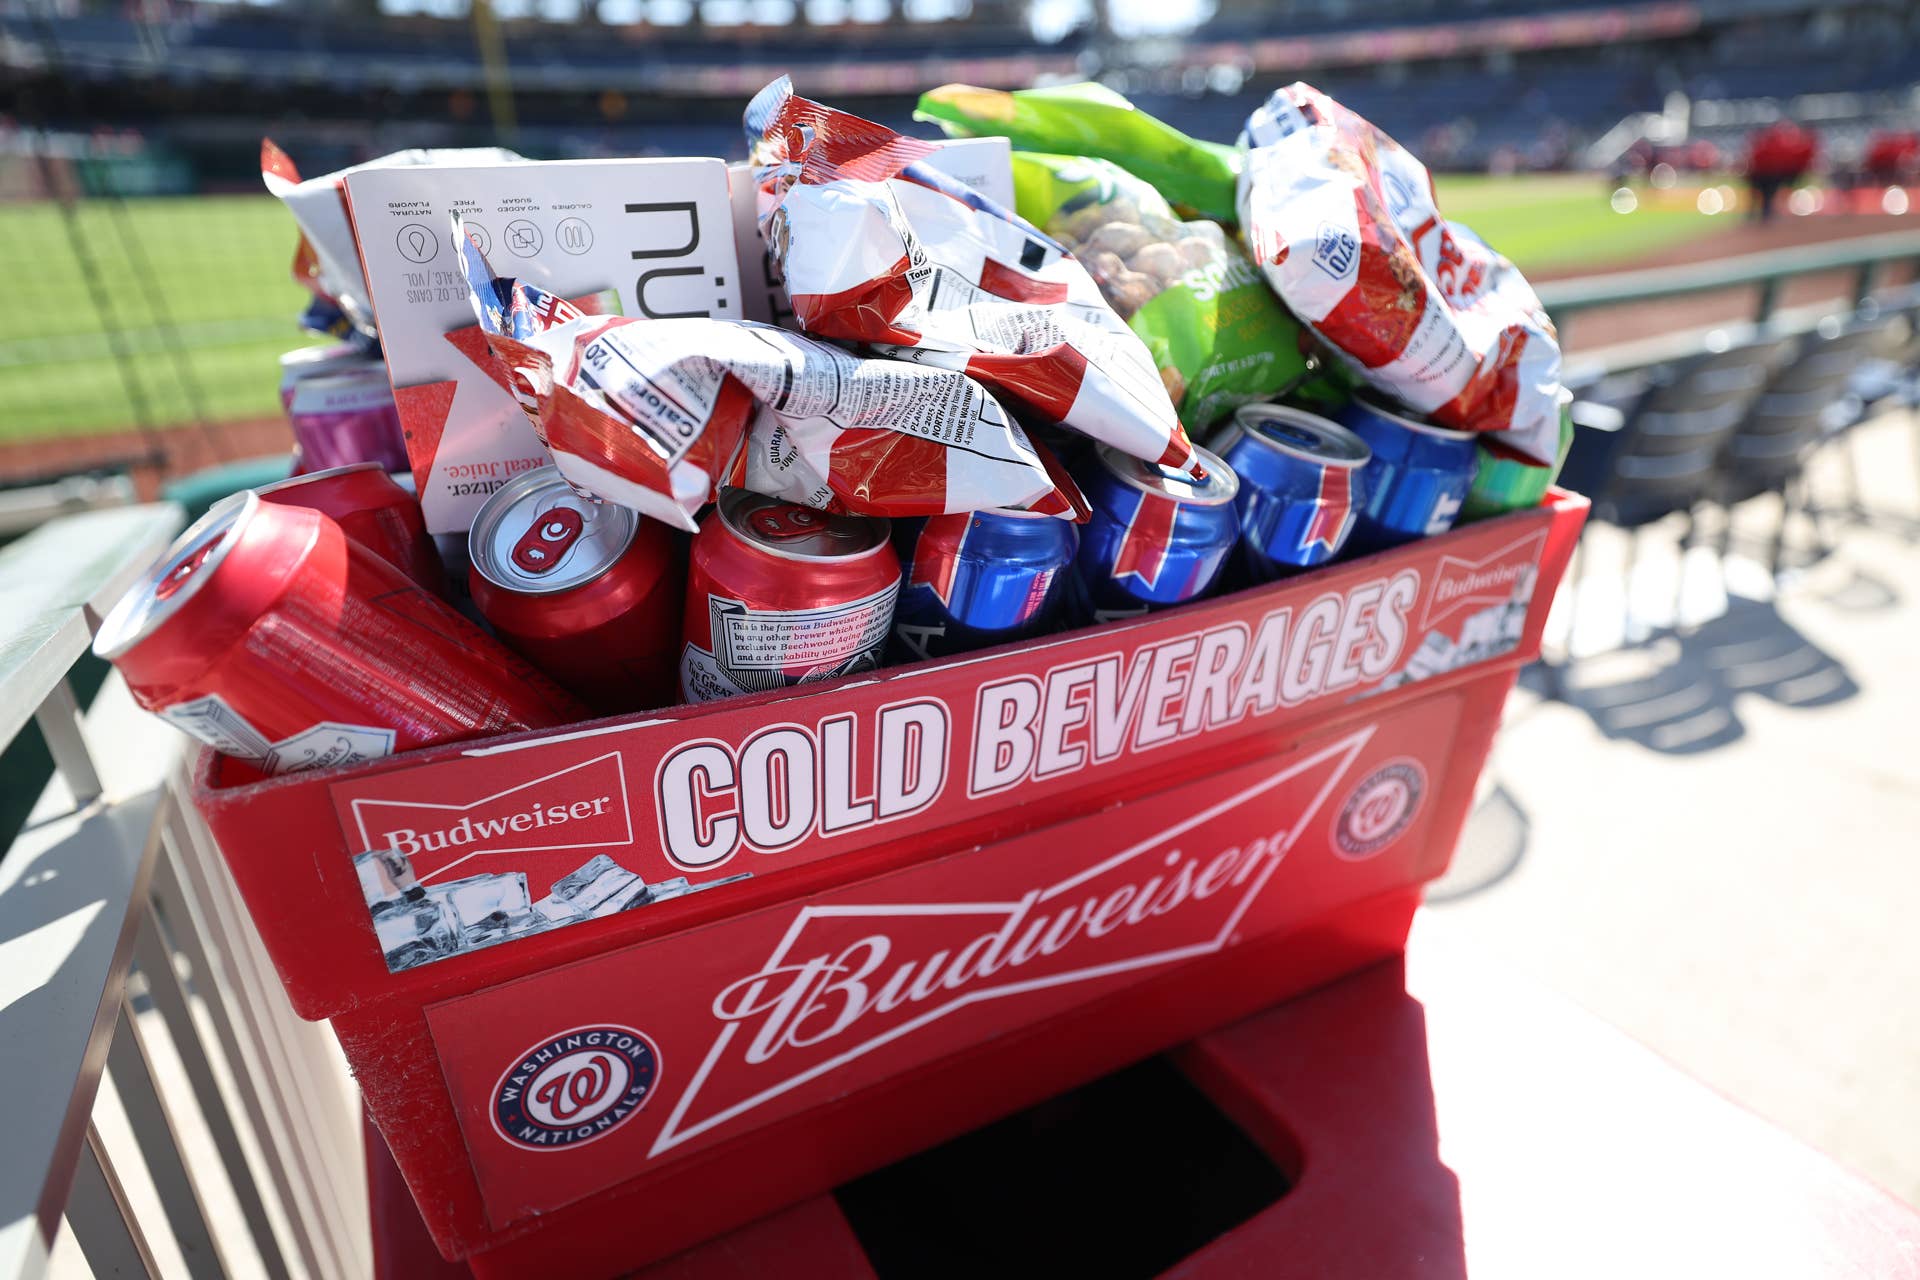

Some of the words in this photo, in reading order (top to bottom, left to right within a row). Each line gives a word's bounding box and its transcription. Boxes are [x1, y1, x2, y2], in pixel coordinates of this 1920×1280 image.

[551, 203, 592, 211] CALORIES
[406, 289, 433, 304] CANS
[585, 343, 615, 373] 120
[891, 376, 920, 426] Manufactured
[924, 407, 935, 426] 2015
[930, 373, 947, 407] FRITO-LA
[925, 393, 933, 401] TX
[931, 409, 945, 438] NORTH
[938, 374, 957, 410] AMERICA
[951, 388, 962, 404] have
[949, 404, 959, 418] may
[942, 417, 954, 441] Peanuts
[954, 420, 966, 443] CHOKE
[967, 421, 976, 439] years
[771, 426, 784, 462] GUARAN
[504, 457, 544, 477] Real
[781, 450, 799, 468] UNTI
[443, 462, 500, 479] Juice.
[447, 479, 512, 497] eltzer.
[806, 486, 829, 507] JUN
[732, 622, 749, 632] This
[751, 623, 758, 631] is
[760, 623, 774, 631] the
[776, 622, 810, 634] famous
[813, 615, 859, 630] Budweiser
[734, 633, 745, 642] by
[746, 634, 764, 643] any
[766, 632, 790, 640] other
[794, 631, 826, 640] brewer
[829, 624, 853, 636] which
[855, 619, 872, 630] costs
[736, 642, 776, 651] exclusive
[781, 638, 834, 651] Beechwood
[837, 633, 861, 643] Aging
[737, 653, 753, 661] and
[763, 651, 819, 662] drinkability
[822, 648, 838, 657] you
[840, 642, 855, 651] will
[701, 674, 735, 697] GREAT
[655, 697, 950, 870] COLD
[967, 569, 1420, 799] BEVERAGES
[382, 795, 611, 857] Budweiser
[713, 830, 1290, 1064] Budweiser
[501, 1032, 646, 1103] WASHINGTON
[519, 1086, 647, 1144] NATIONALS
